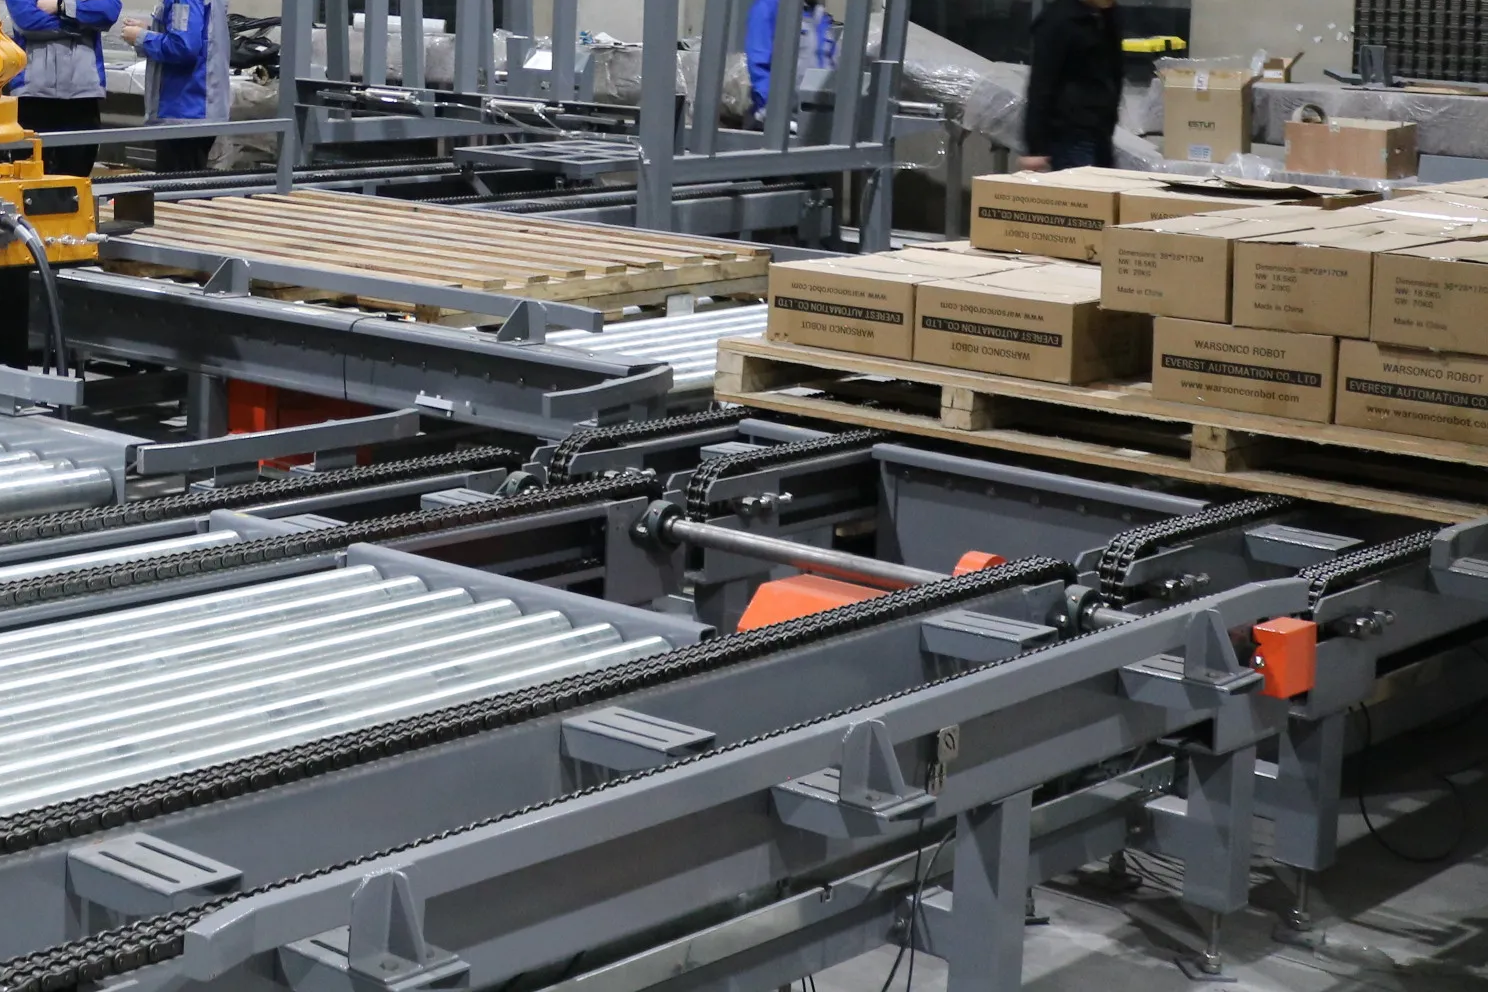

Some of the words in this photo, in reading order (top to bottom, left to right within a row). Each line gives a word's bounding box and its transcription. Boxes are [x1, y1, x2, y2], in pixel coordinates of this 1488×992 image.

[994, 193, 1089, 209] www.warsoncorobot.com
[980, 209, 996, 218] LTD
[1013, 212, 1067, 226] AUTOMATION
[1067, 217, 1103, 230] EVEREST
[1005, 229, 1030, 238] ROBOT
[1031, 231, 1076, 244] WARSONCO
[791, 282, 887, 300] www.warsoncorobot.com
[1117, 286, 1134, 294] Made
[1144, 289, 1163, 297] China
[778, 299, 793, 307] LTD
[1254, 302, 1272, 310] Made
[1283, 305, 1304, 314] China
[811, 302, 862, 318] AUTOMATION
[940, 302, 1044, 321] www.warsoncorobot.com
[866, 312, 901, 323] EVEREST
[925, 318, 942, 328] LTD
[801, 321, 827, 331] ROBOT
[830, 324, 875, 338] WARSONCO
[963, 323, 1019, 338] AUTOMATION
[1022, 333, 1060, 345] EVEREST
[951, 342, 978, 353] ROBOT
[981, 347, 1030, 360] WARSONCO
[1194, 340, 1250, 355] WARSONCO
[1252, 346, 1286, 359] ROBOT
[1165, 358, 1205, 370] EVEREST
[1208, 363, 1273, 379] AUTOMATION
[1297, 373, 1317, 385] LTD
[1383, 363, 1443, 379] WARSONCO
[1446, 371, 1484, 384] ROBOT
[1180, 380, 1300, 403] www.warsoncorobot.com
[1349, 380, 1393, 395] EVEREST
[1397, 388, 1469, 406] AUTOMATION
[1366, 405, 1488, 429] www.warsoncorobot.co
